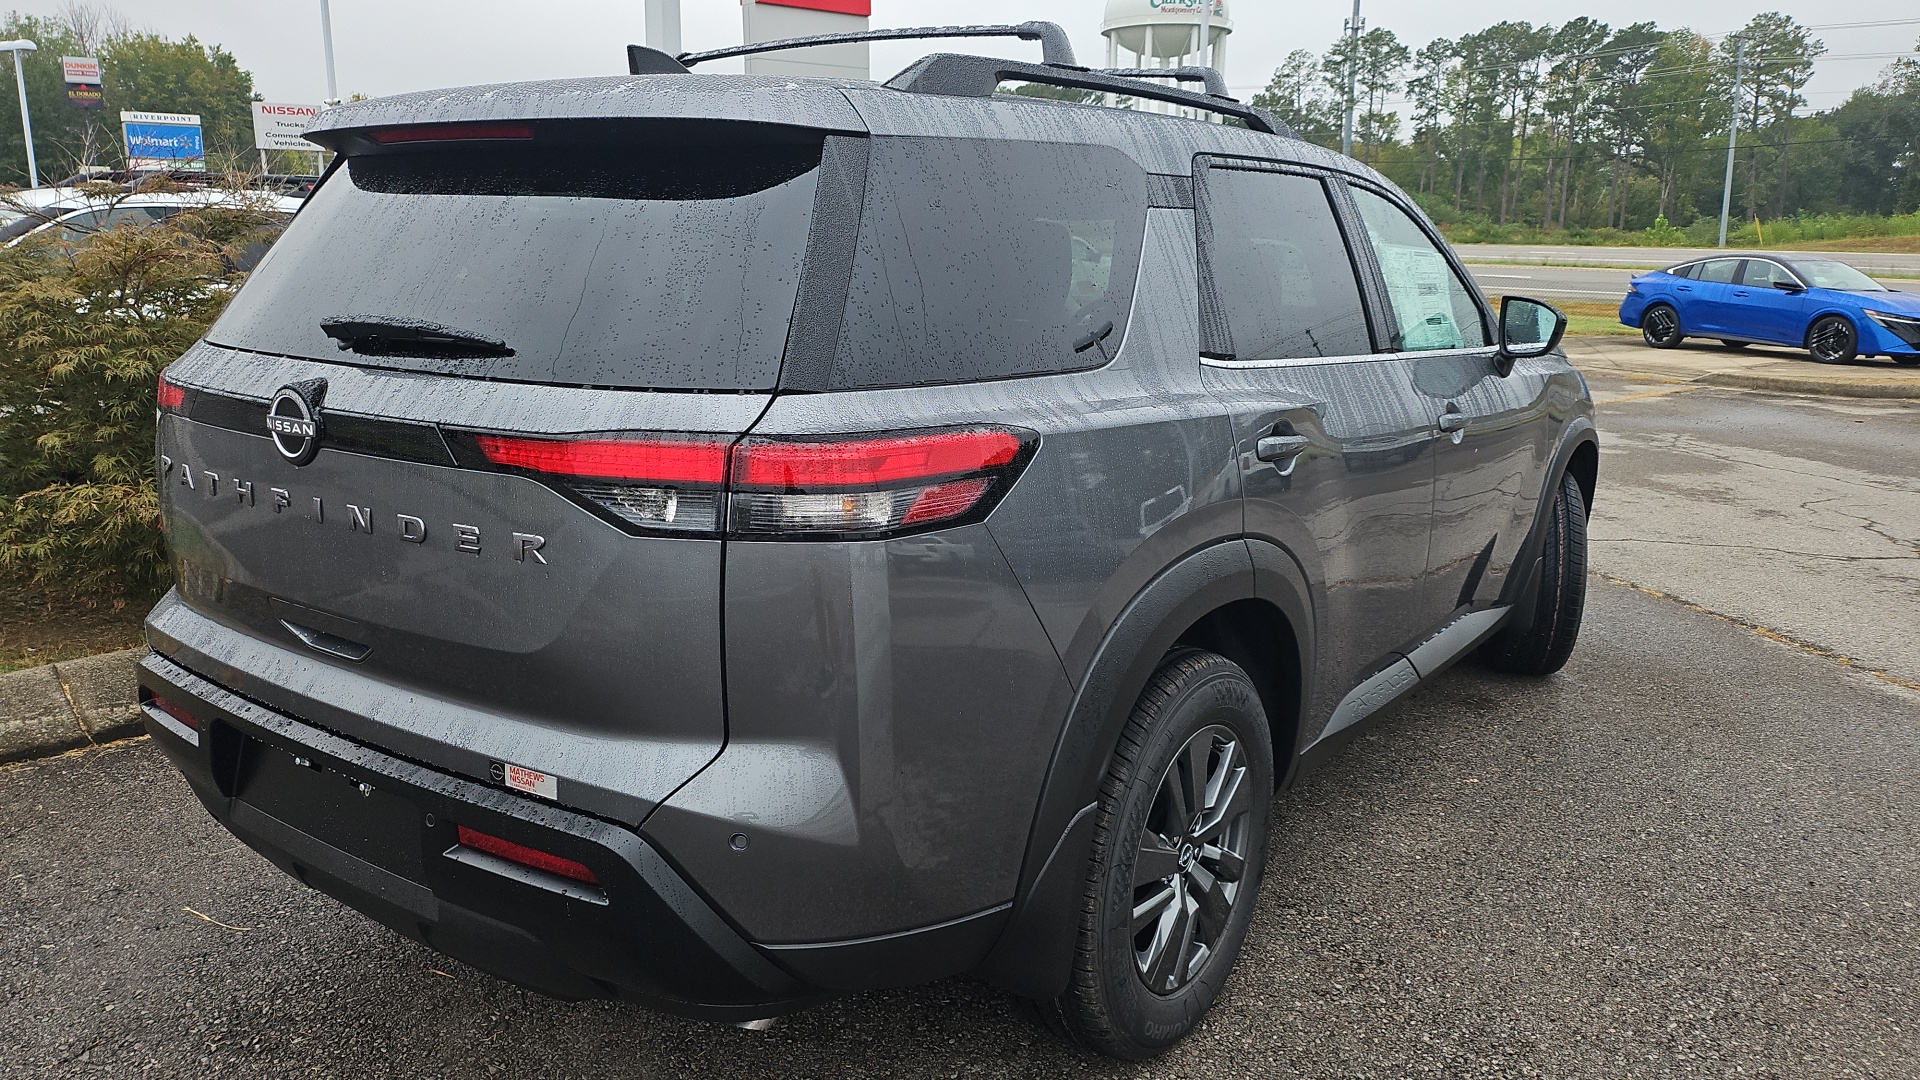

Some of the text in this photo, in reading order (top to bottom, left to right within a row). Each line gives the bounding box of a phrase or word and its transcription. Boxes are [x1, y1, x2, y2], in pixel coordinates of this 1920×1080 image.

[1160, 6, 1196, 15] Montgomery
[76, 90, 102, 98] DORADO
[261, 105, 316, 116] NISSAN
[133, 114, 192, 122] RIVERPOINT
[129, 135, 179, 147] Walmart
[266, 417, 314, 436] NISSAN
[160, 454, 548, 566] PATHFINDER
[509, 766, 545, 783] MATHEWS
[509, 774, 535, 787] NISSAN
[1145, 1016, 1191, 1040] KUMHO
